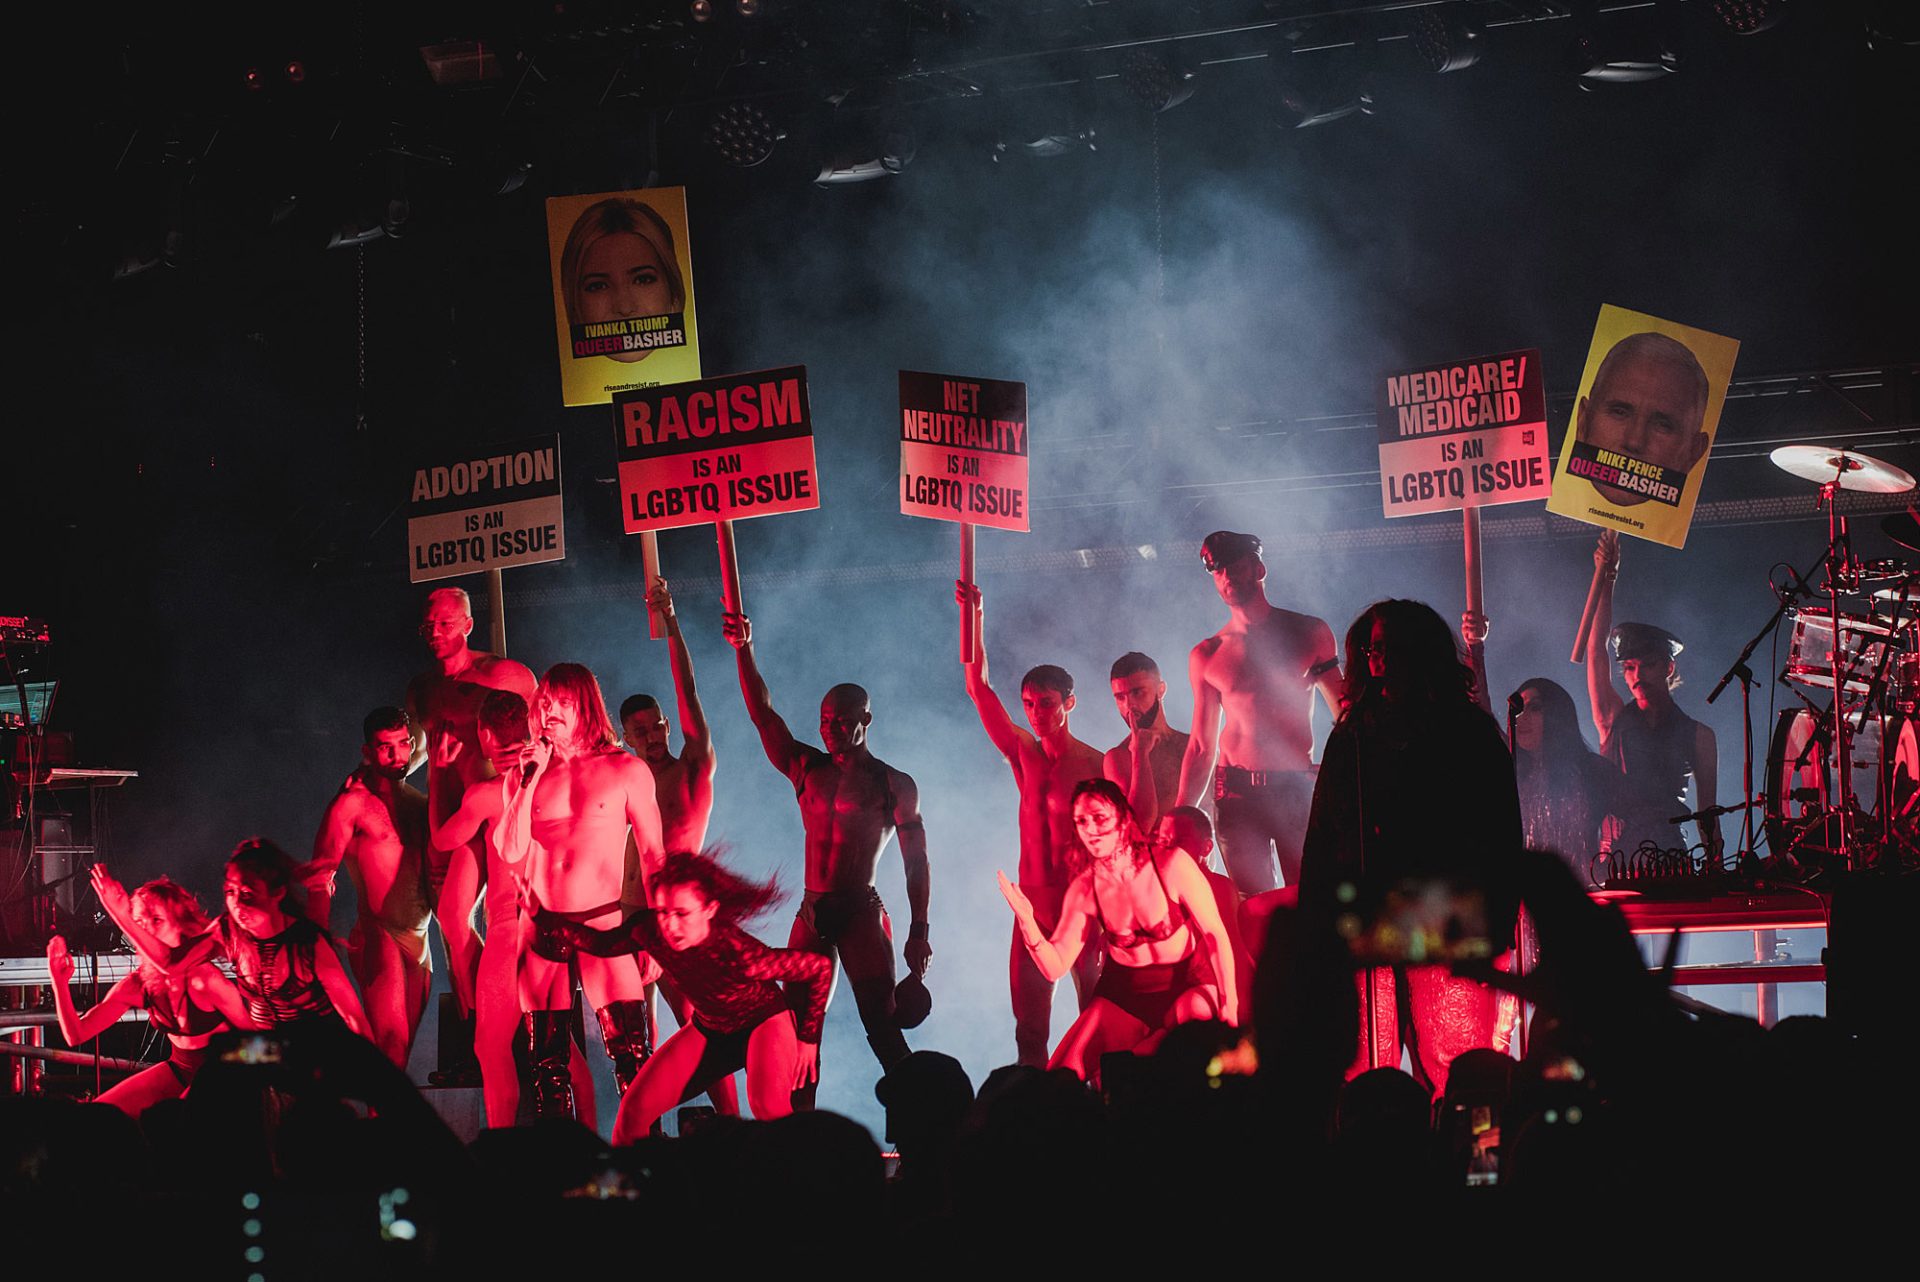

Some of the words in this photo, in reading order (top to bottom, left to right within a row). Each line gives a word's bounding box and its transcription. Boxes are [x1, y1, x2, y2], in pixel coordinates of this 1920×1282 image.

[574, 329, 684, 356] QUEERBASHER
[585, 321, 627, 339] IVANKA
[627, 316, 670, 334] TRUMP
[944, 381, 981, 414] NET
[1387, 356, 1528, 407] MEDICARE/
[623, 378, 802, 447] RACISM
[904, 409, 1024, 453] NEUTRALITY
[1398, 390, 1521, 436] MEDICAID
[692, 458, 710, 478] IS
[716, 454, 741, 475] AN
[947, 454, 959, 474] IS
[962, 457, 979, 477] AN
[1441, 442, 1457, 462] IS
[1461, 438, 1483, 459] AN
[1596, 448, 1627, 470] MIKE
[1626, 457, 1664, 481] PENCE
[411, 447, 554, 502] ADOPTION
[631, 483, 720, 521] LGBTQ
[729, 470, 810, 507] ISSUE
[905, 474, 962, 513] LGBTQ
[968, 483, 1023, 518] ISSUE
[1389, 469, 1465, 504] LGBTQ
[1473, 457, 1543, 494] ISSUE
[1570, 457, 1679, 503] QUEERBASHER
[465, 515, 479, 532] IS
[483, 511, 503, 529] AN
[1588, 507, 1645, 529] riseandresist.org
[416, 537, 485, 570] LGBTQ
[492, 525, 556, 558] ISSUE
